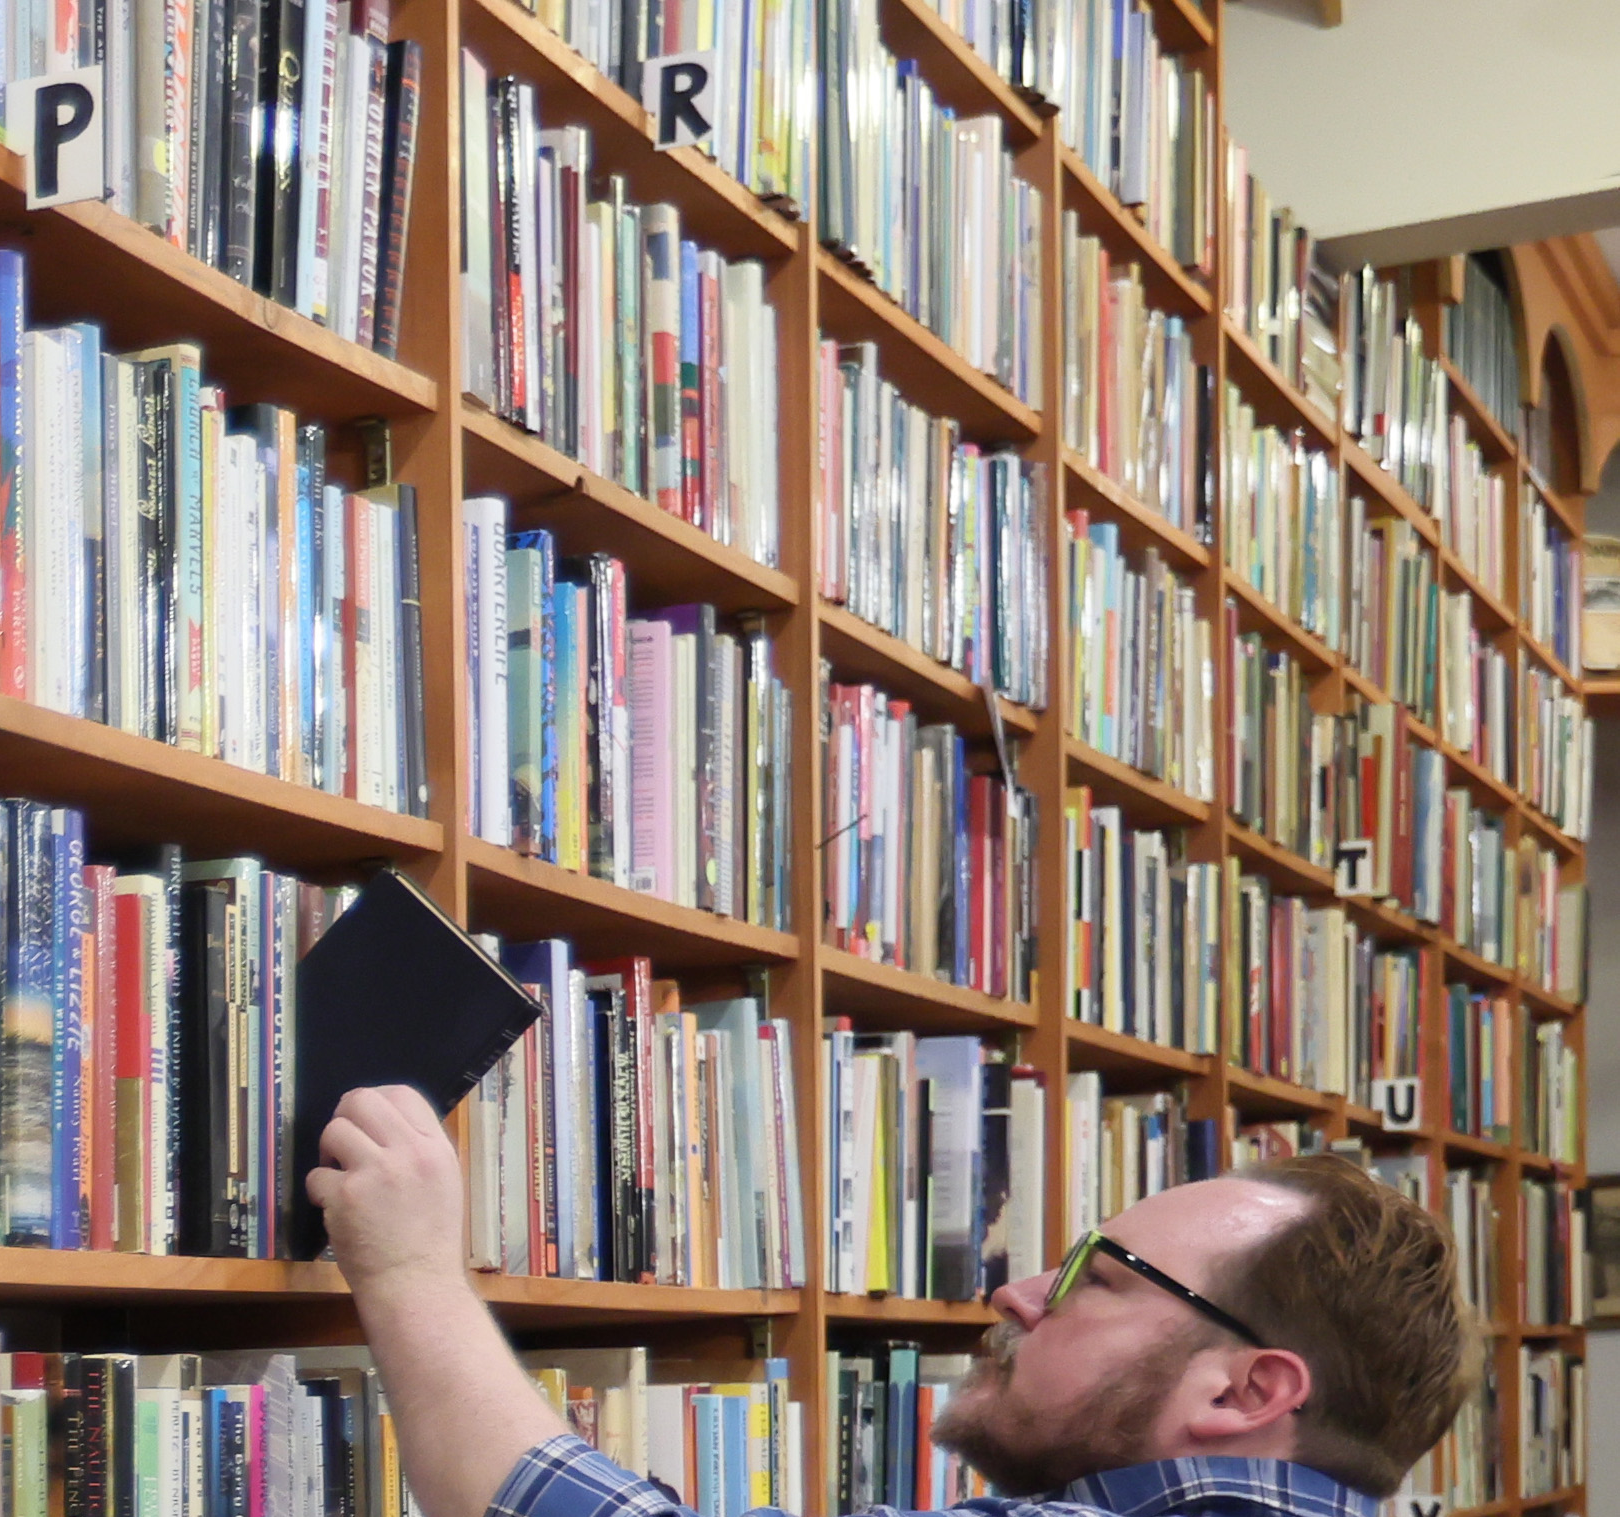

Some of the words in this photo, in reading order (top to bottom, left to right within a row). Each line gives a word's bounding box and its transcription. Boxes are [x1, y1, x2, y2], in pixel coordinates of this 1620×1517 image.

[33, 82, 95, 200] P
[659, 61, 713, 146] R
[364, 103, 384, 193] ORHAN
[359, 207, 380, 300] PAMUK
[186, 376, 202, 461] CHURCH
[187, 493, 206, 596] MARVELS
[66, 839, 84, 939] GEORGE
[1337, 846, 1370, 889] T
[66, 967, 84, 1052] LIZZIE
[1384, 1083, 1416, 1127] U
[70, 1133, 83, 1182] Pearl
[65, 1411, 80, 1451] THE
[87, 1371, 103, 1416] THE
[234, 1412, 244, 1445] The
[231, 1452, 246, 1507] Berry
